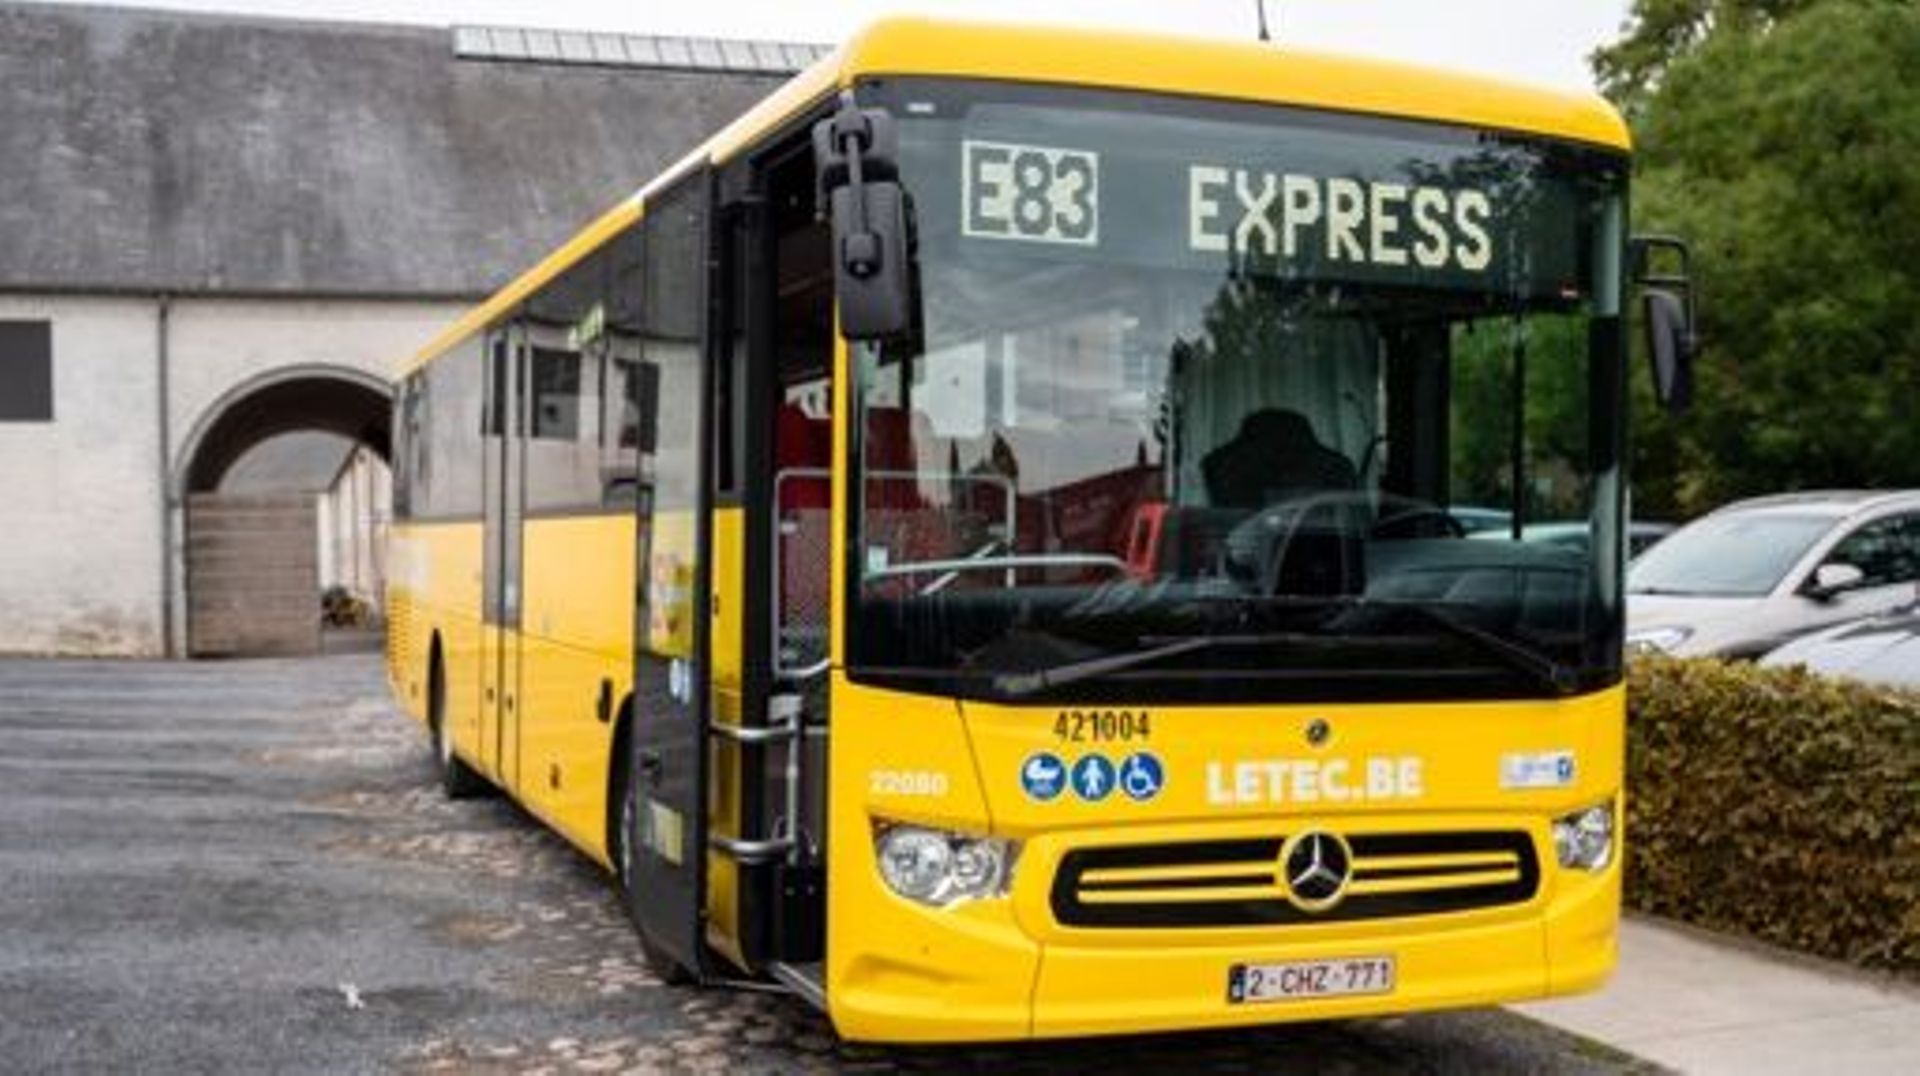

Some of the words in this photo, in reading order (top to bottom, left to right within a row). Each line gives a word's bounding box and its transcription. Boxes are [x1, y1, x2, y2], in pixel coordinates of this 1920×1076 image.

[969, 147, 1094, 240] E83
[1189, 166, 1492, 270] EXPRESS
[1053, 710, 1150, 742] 421004
[1206, 756, 1423, 805] LETEC.BE
[1250, 960, 1388, 997] 2-CHZ-771
